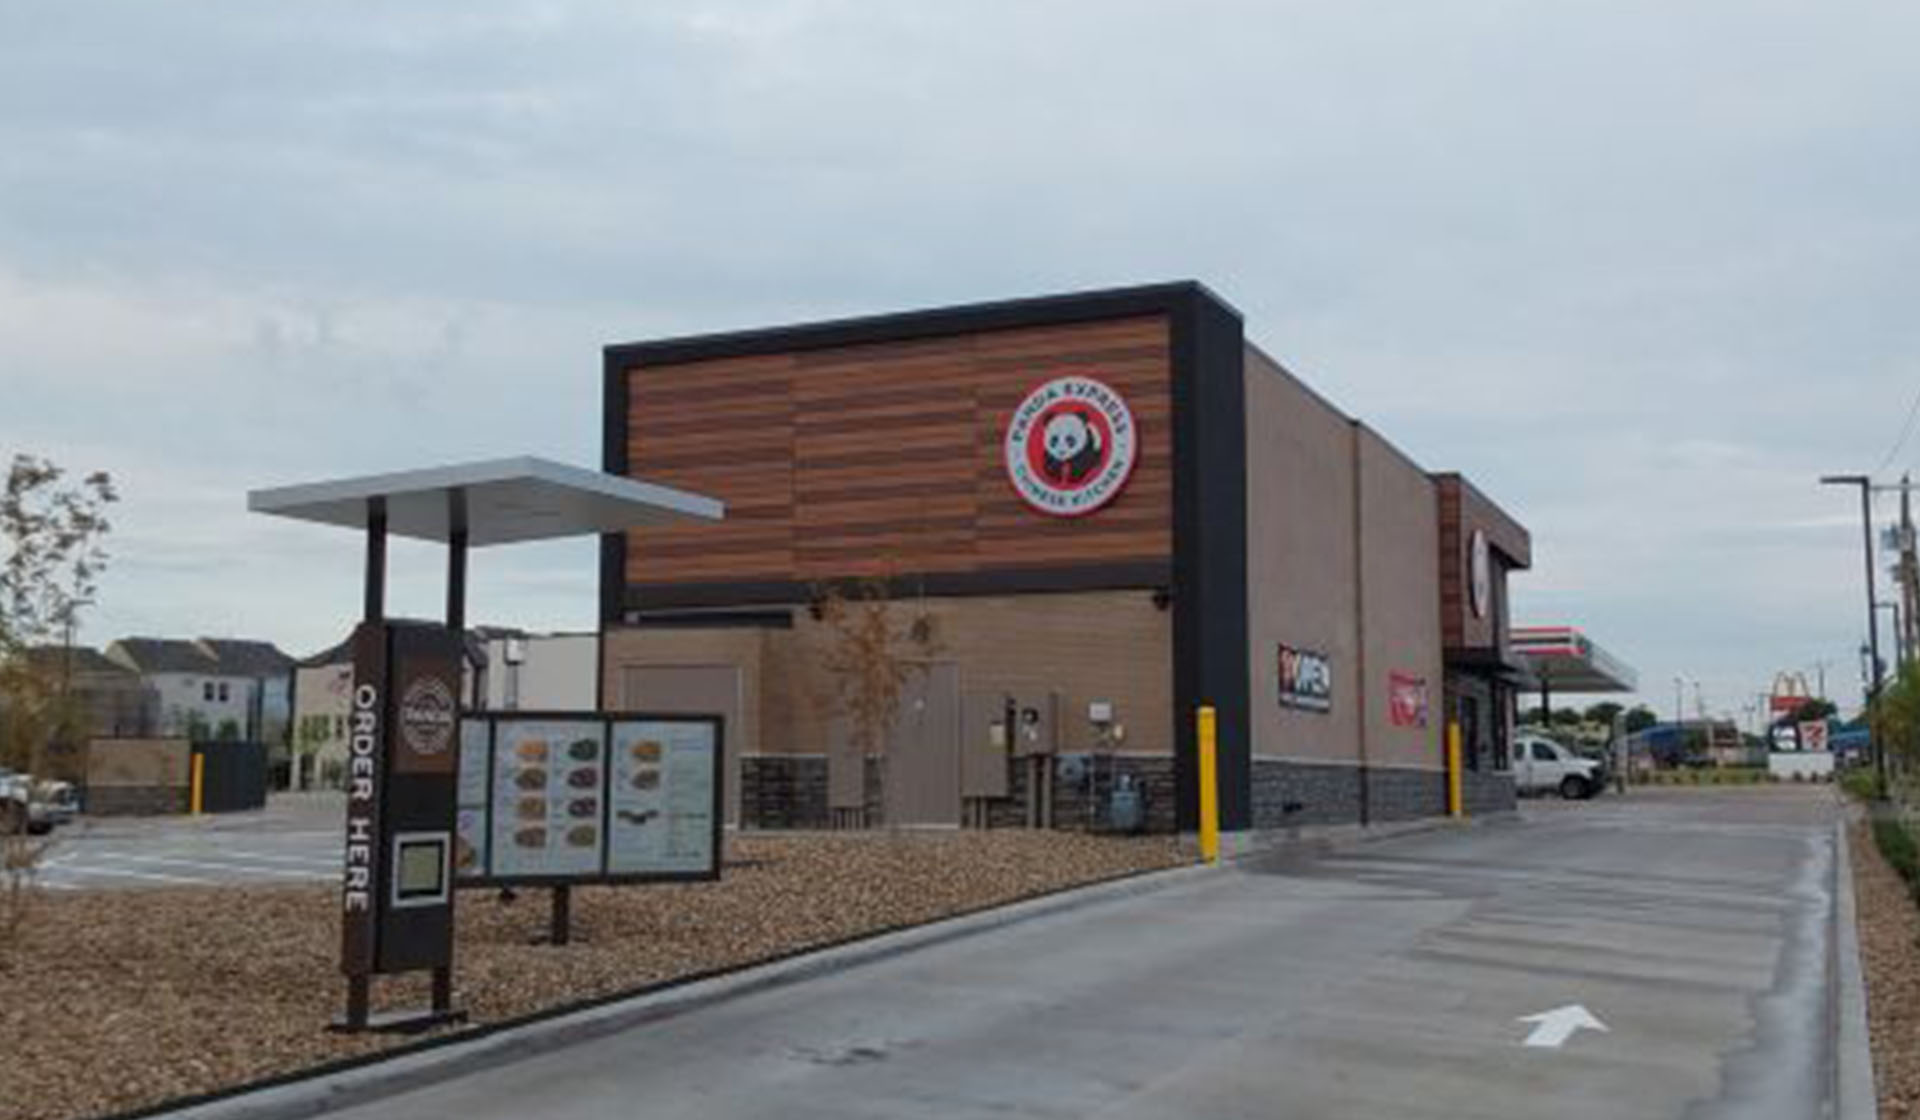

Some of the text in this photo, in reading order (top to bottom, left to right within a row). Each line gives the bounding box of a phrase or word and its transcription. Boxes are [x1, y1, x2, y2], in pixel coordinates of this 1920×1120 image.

[1011, 383, 1127, 442] PANDA EXPRESS
[347, 685, 377, 911] ORDER HERE
